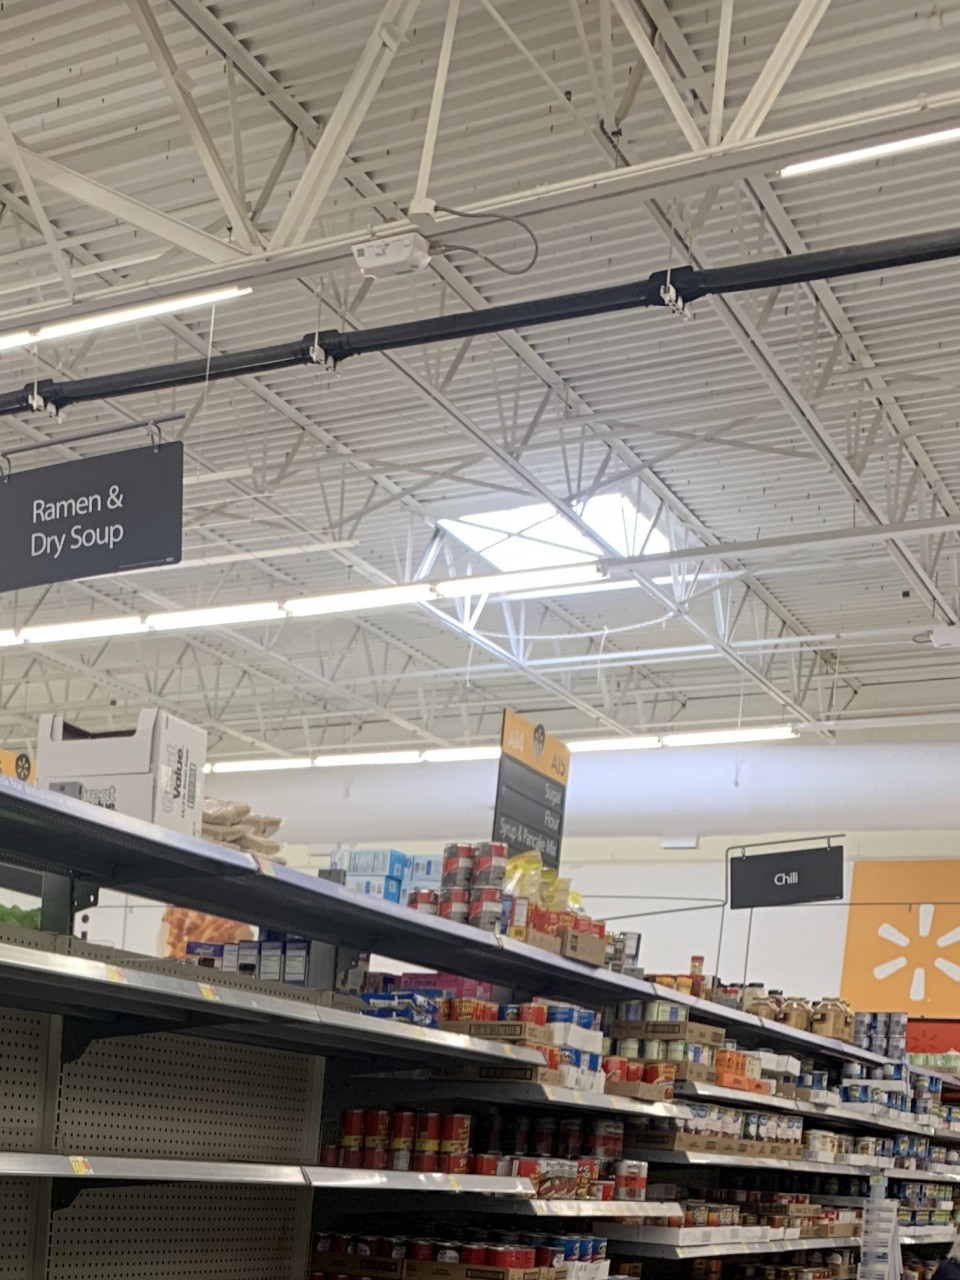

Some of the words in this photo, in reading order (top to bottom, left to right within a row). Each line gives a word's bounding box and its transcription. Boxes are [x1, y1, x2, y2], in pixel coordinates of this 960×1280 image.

[32, 494, 102, 524] Ramen
[106, 485, 124, 509] &
[30, 532, 67, 559] Dry
[70, 523, 125, 550] Soup
[544, 783, 562, 806] Sugar
[544, 810, 560, 831] Flour
[500, 817, 517, 842] Syrup
[523, 827, 547, 853] Pancake
[546, 838, 558, 858] Mix
[773, 871, 799, 886] Chili
